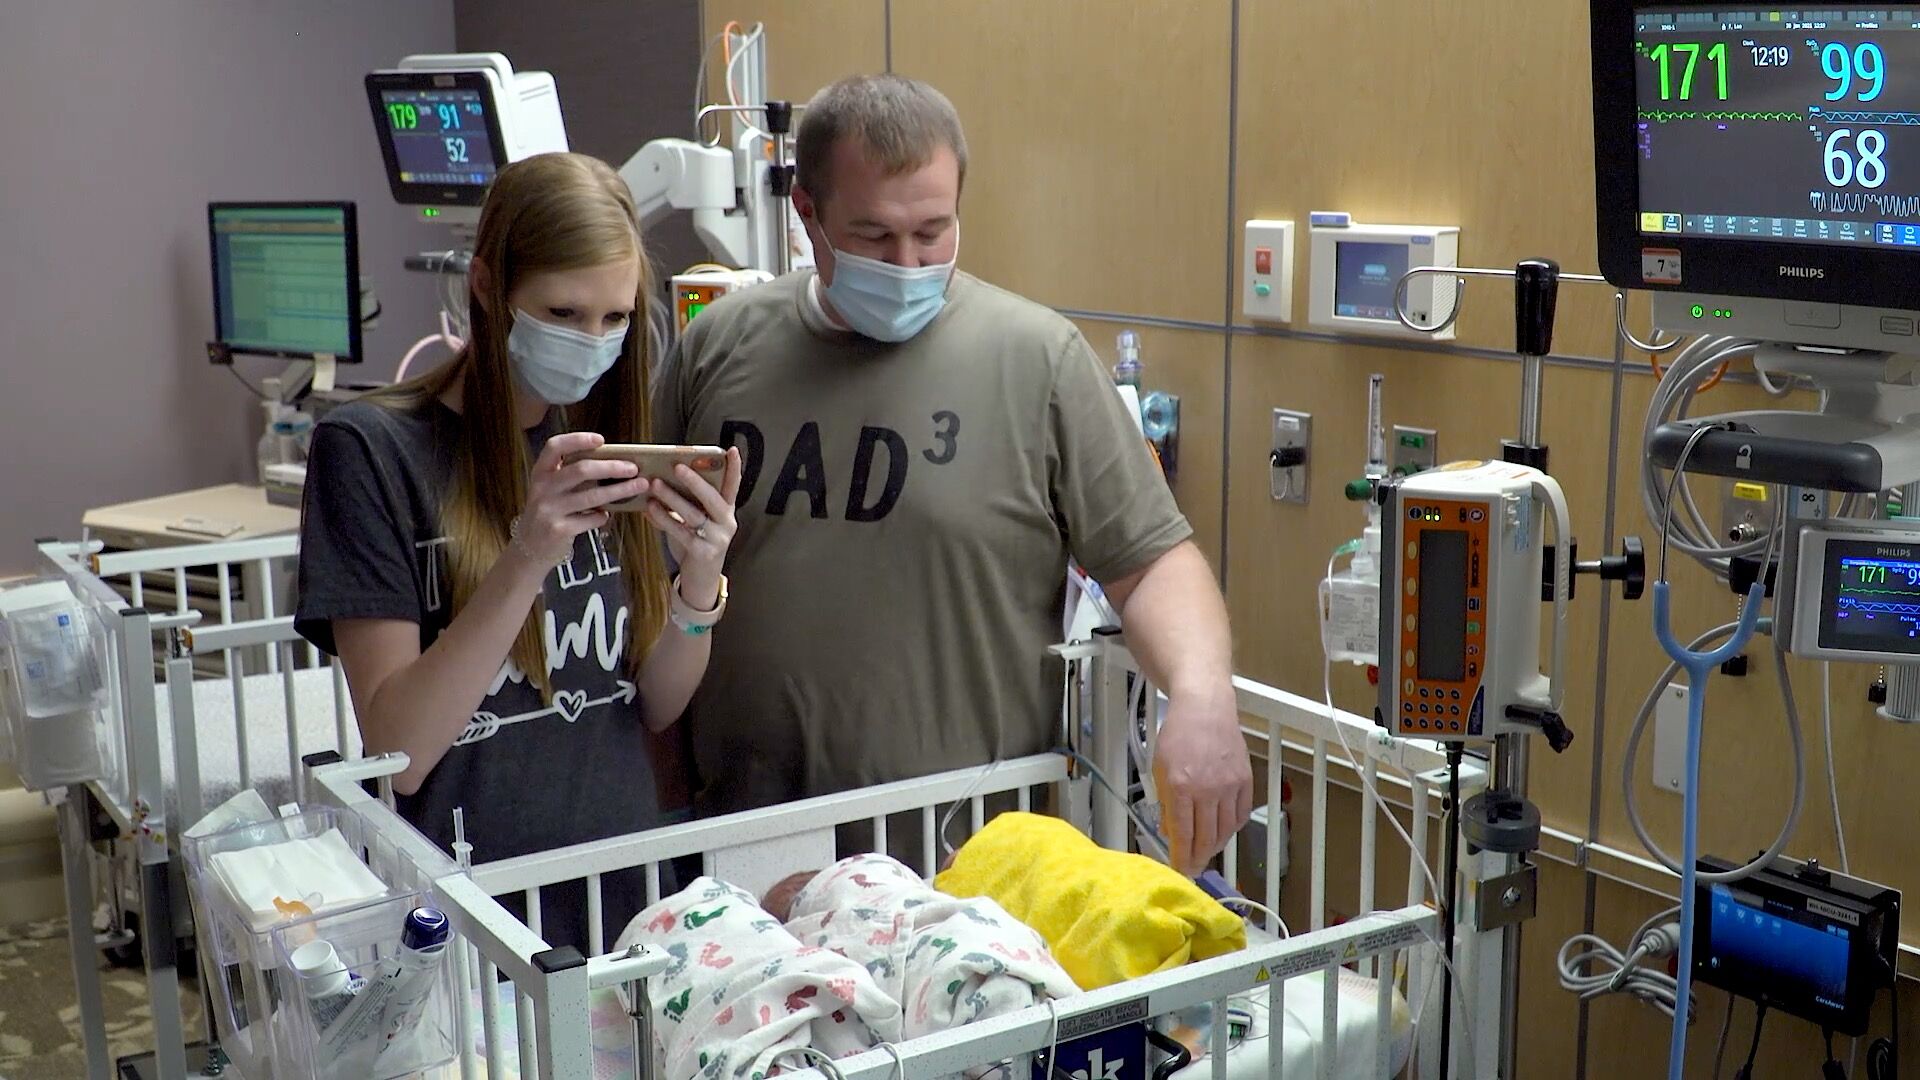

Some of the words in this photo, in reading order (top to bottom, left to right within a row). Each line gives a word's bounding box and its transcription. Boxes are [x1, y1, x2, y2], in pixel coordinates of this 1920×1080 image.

[1751, 46, 1789, 66] 12:19
[1650, 43, 1727, 100] 171
[1821, 43, 1884, 101] 99
[390, 104, 417, 129] 179
[438, 103, 461, 129] 91
[446, 137, 469, 162] 52
[1824, 128, 1886, 188] 68
[1657, 259, 1665, 272] 7
[1779, 266, 1825, 279] PHILIPS
[1876, 547, 1911, 557] PHILIPS
[1859, 566, 1885, 584] 171
[1908, 568, 1920, 586] 9
